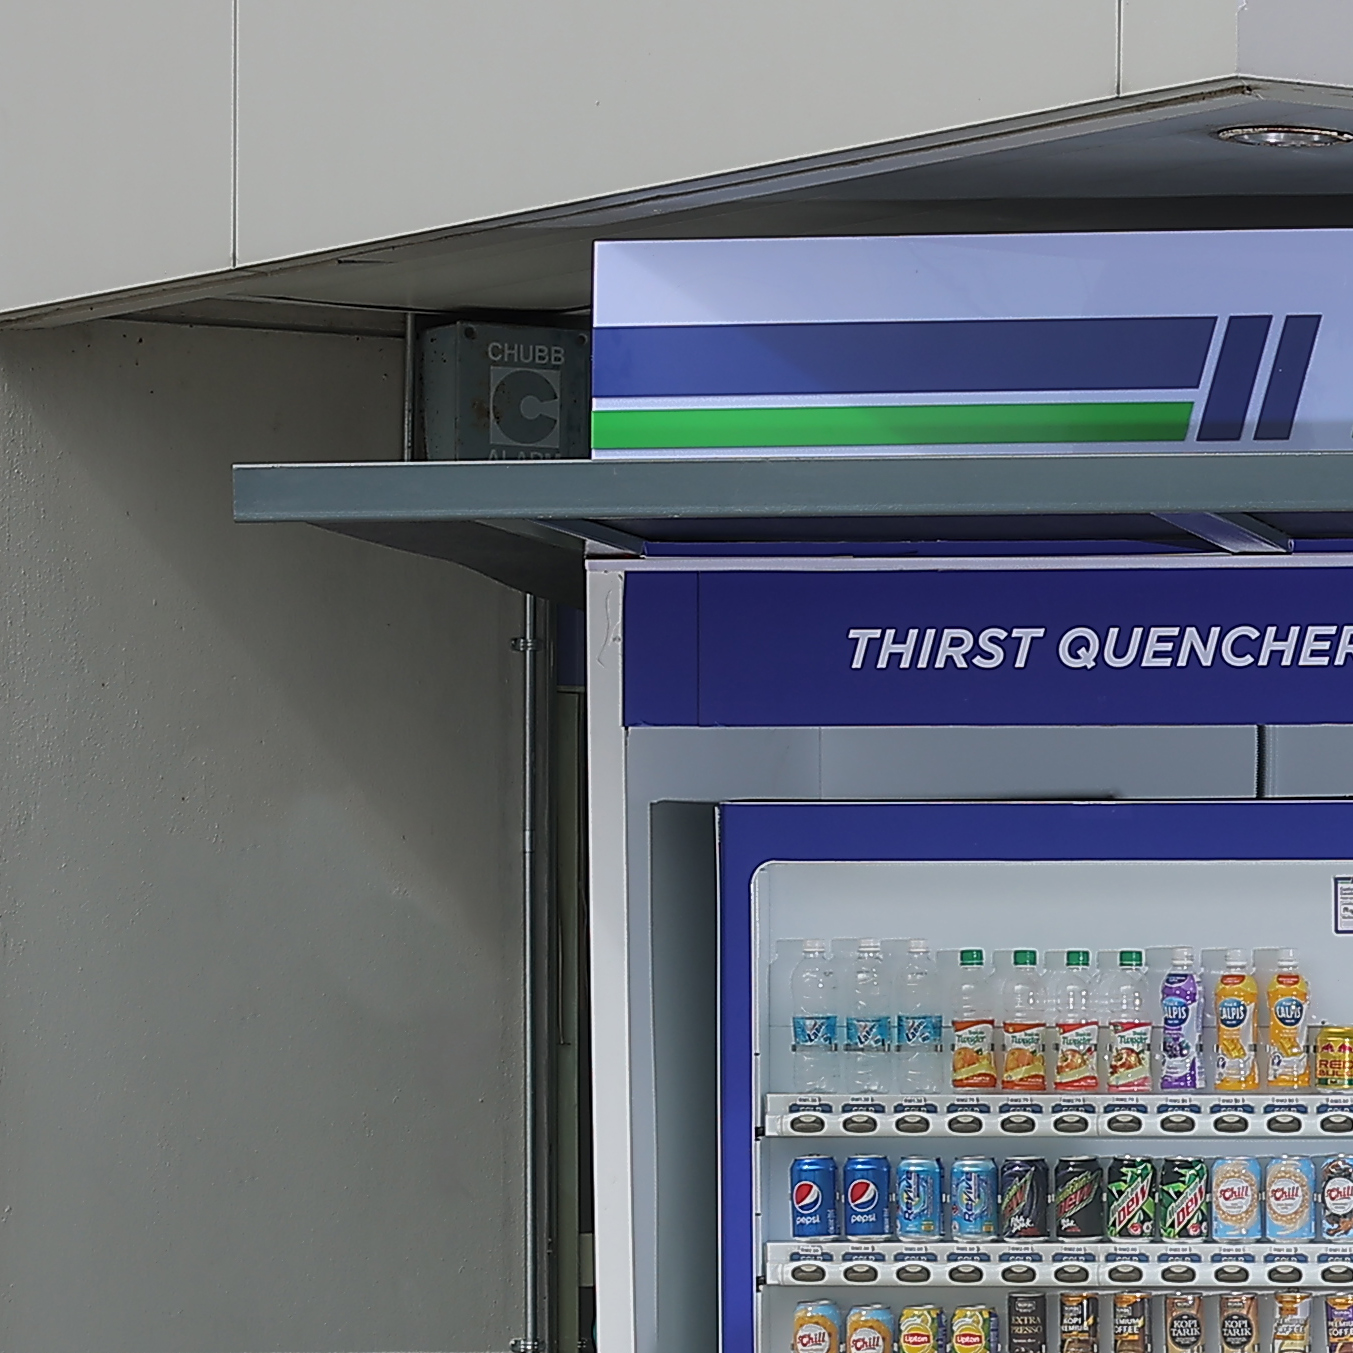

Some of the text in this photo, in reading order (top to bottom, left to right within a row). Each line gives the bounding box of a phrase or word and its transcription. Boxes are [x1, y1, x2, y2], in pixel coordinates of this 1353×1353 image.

[487, 342, 565, 364] CHUBB
[847, 628, 1045, 669] THIRST
[796, 1215, 821, 1226] pepsi
[850, 1212, 877, 1224] pepsi
[1012, 1316, 1041, 1325] EXTRA
[1173, 1319, 1199, 1328] KOPI
[1224, 1319, 1249, 1328] KOPI
[1170, 1327, 1200, 1337] TARIK
[1222, 1327, 1252, 1337] TARIK
[904, 1334, 931, 1344] Lipton
[956, 1333, 982, 1344] Lipton
